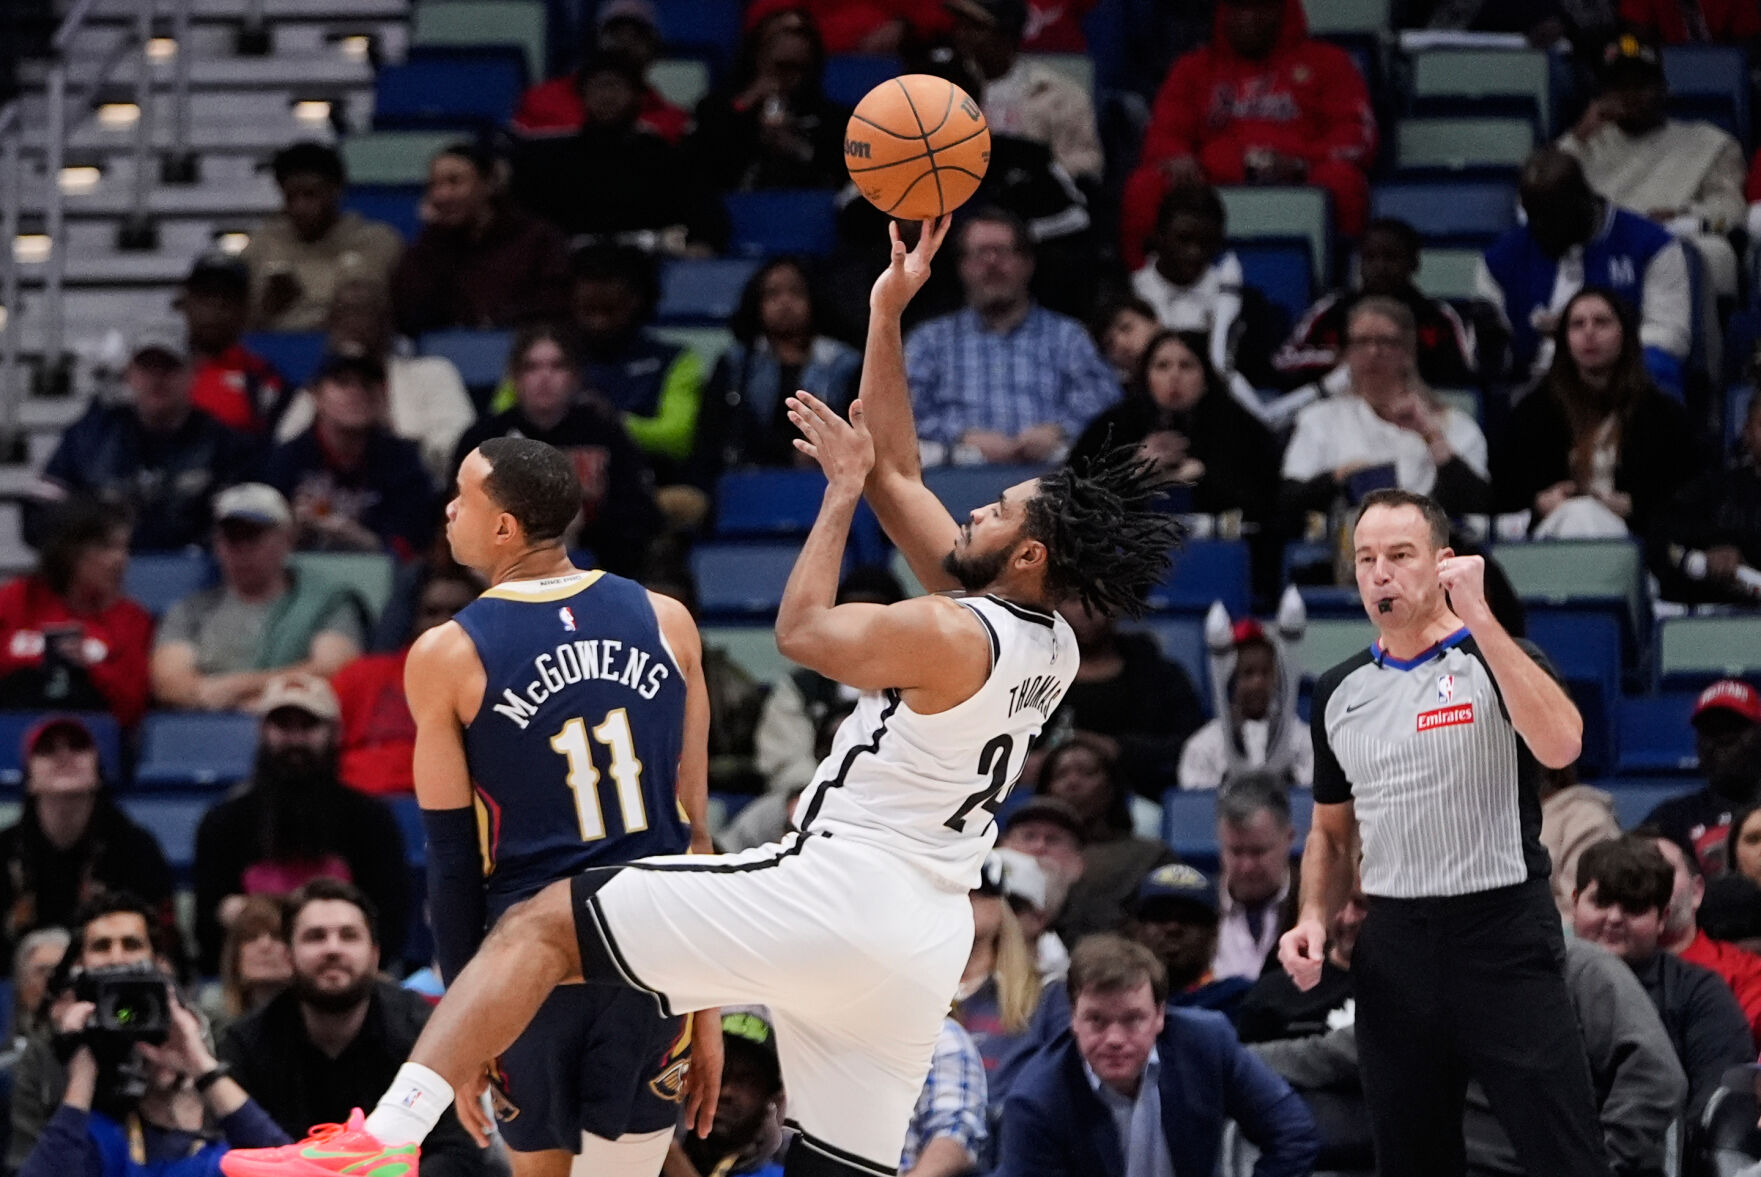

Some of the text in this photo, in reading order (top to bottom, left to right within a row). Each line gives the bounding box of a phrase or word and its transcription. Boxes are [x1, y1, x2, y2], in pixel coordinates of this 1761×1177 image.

[493, 639, 669, 729] McGOWENS
[1418, 708, 1472, 728] Emirates
[549, 707, 649, 842] 11
